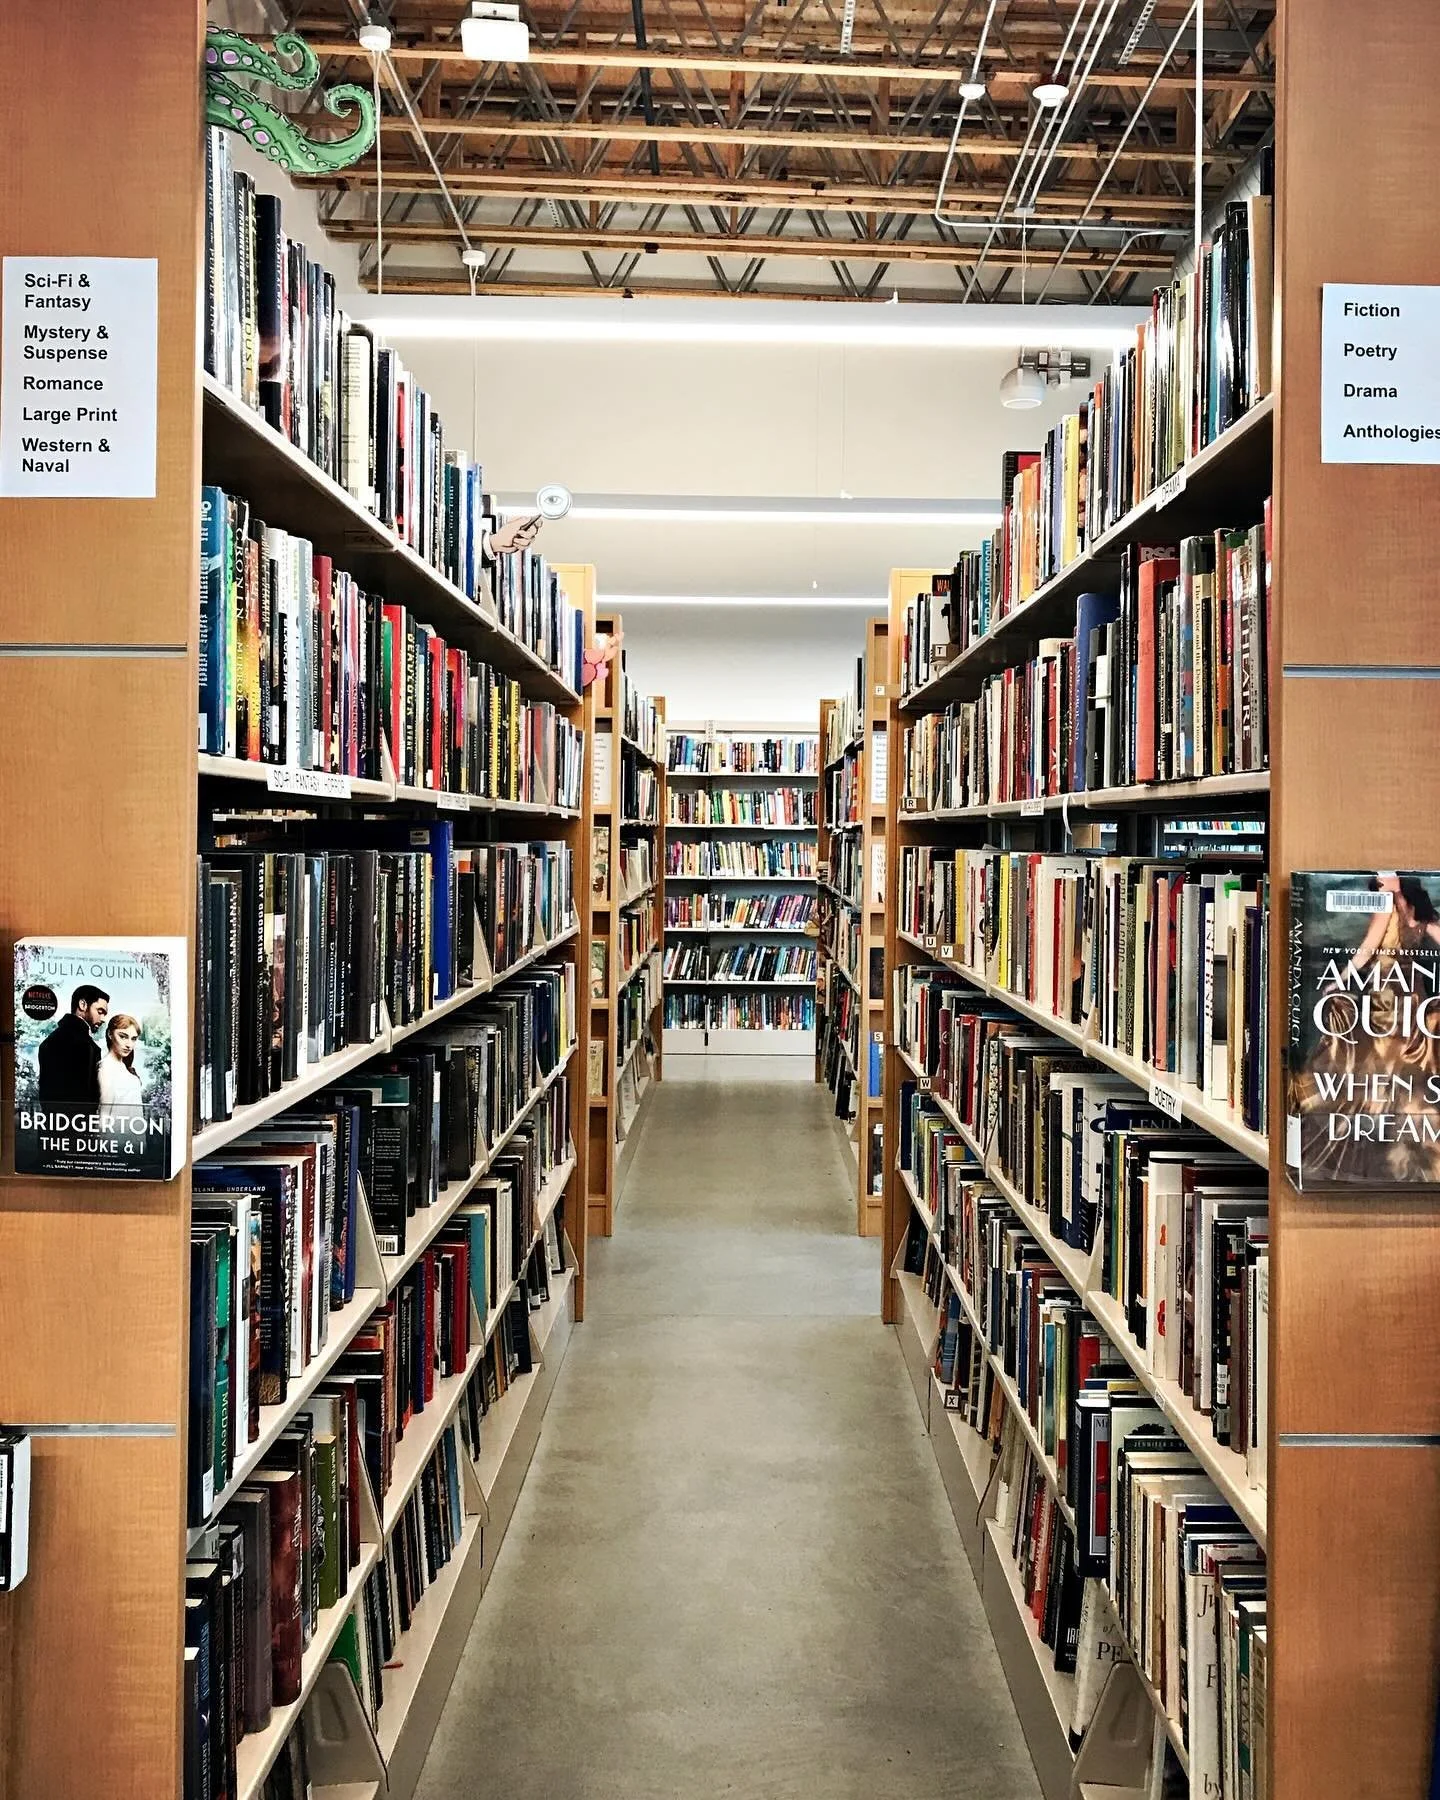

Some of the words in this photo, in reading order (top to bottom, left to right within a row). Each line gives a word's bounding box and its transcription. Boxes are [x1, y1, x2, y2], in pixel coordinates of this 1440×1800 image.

[24, 273, 72, 288] Sci-Fi
[78, 274, 90, 288] &
[24, 294, 91, 312] Fantasy
[1344, 302, 1400, 318] Fiction
[24, 325, 91, 342] Mystery
[96, 325, 109, 339] &
[23, 346, 108, 363] Suspense
[1344, 343, 1398, 361] Poetry
[23, 376, 104, 391] Romance
[1344, 383, 1398, 398] Drama
[22, 407, 71, 425] Large
[77, 407, 118, 422] Print
[1343, 424, 1440, 442] Anthologies
[22, 437, 92, 453] Western
[98, 439, 111, 453] &
[22, 458, 70, 473] Naval
[1161, 475, 1180, 503] DRAMA
[236, 527, 244, 620] CRONIN
[936, 646, 943, 655] T
[1241, 614, 1251, 741] THEATRE
[907, 799, 914, 808] R
[927, 937, 934, 947] U
[943, 947, 950, 956] V
[1293, 917, 1304, 990] AMANDA
[1323, 946, 1341, 955] NEW
[1371, 947, 1396, 956] TIMES
[1399, 948, 1440, 957] BESTSELL
[38, 961, 85, 977] JULIA
[90, 964, 145, 980] QUINN
[1316, 958, 1440, 993] AMAN
[1291, 993, 1302, 1049] QUICK
[921, 1078, 931, 1088] W
[1313, 1072, 1413, 1103] WHEN
[1155, 1086, 1177, 1115] POETRY
[20, 1111, 164, 1136] BRIDGERTON
[40, 1136, 70, 1152] THE
[76, 1137, 118, 1153] DUKE
[124, 1140, 135, 1155] &
[139, 1141, 144, 1155] I
[948, 1396, 956, 1406] X
